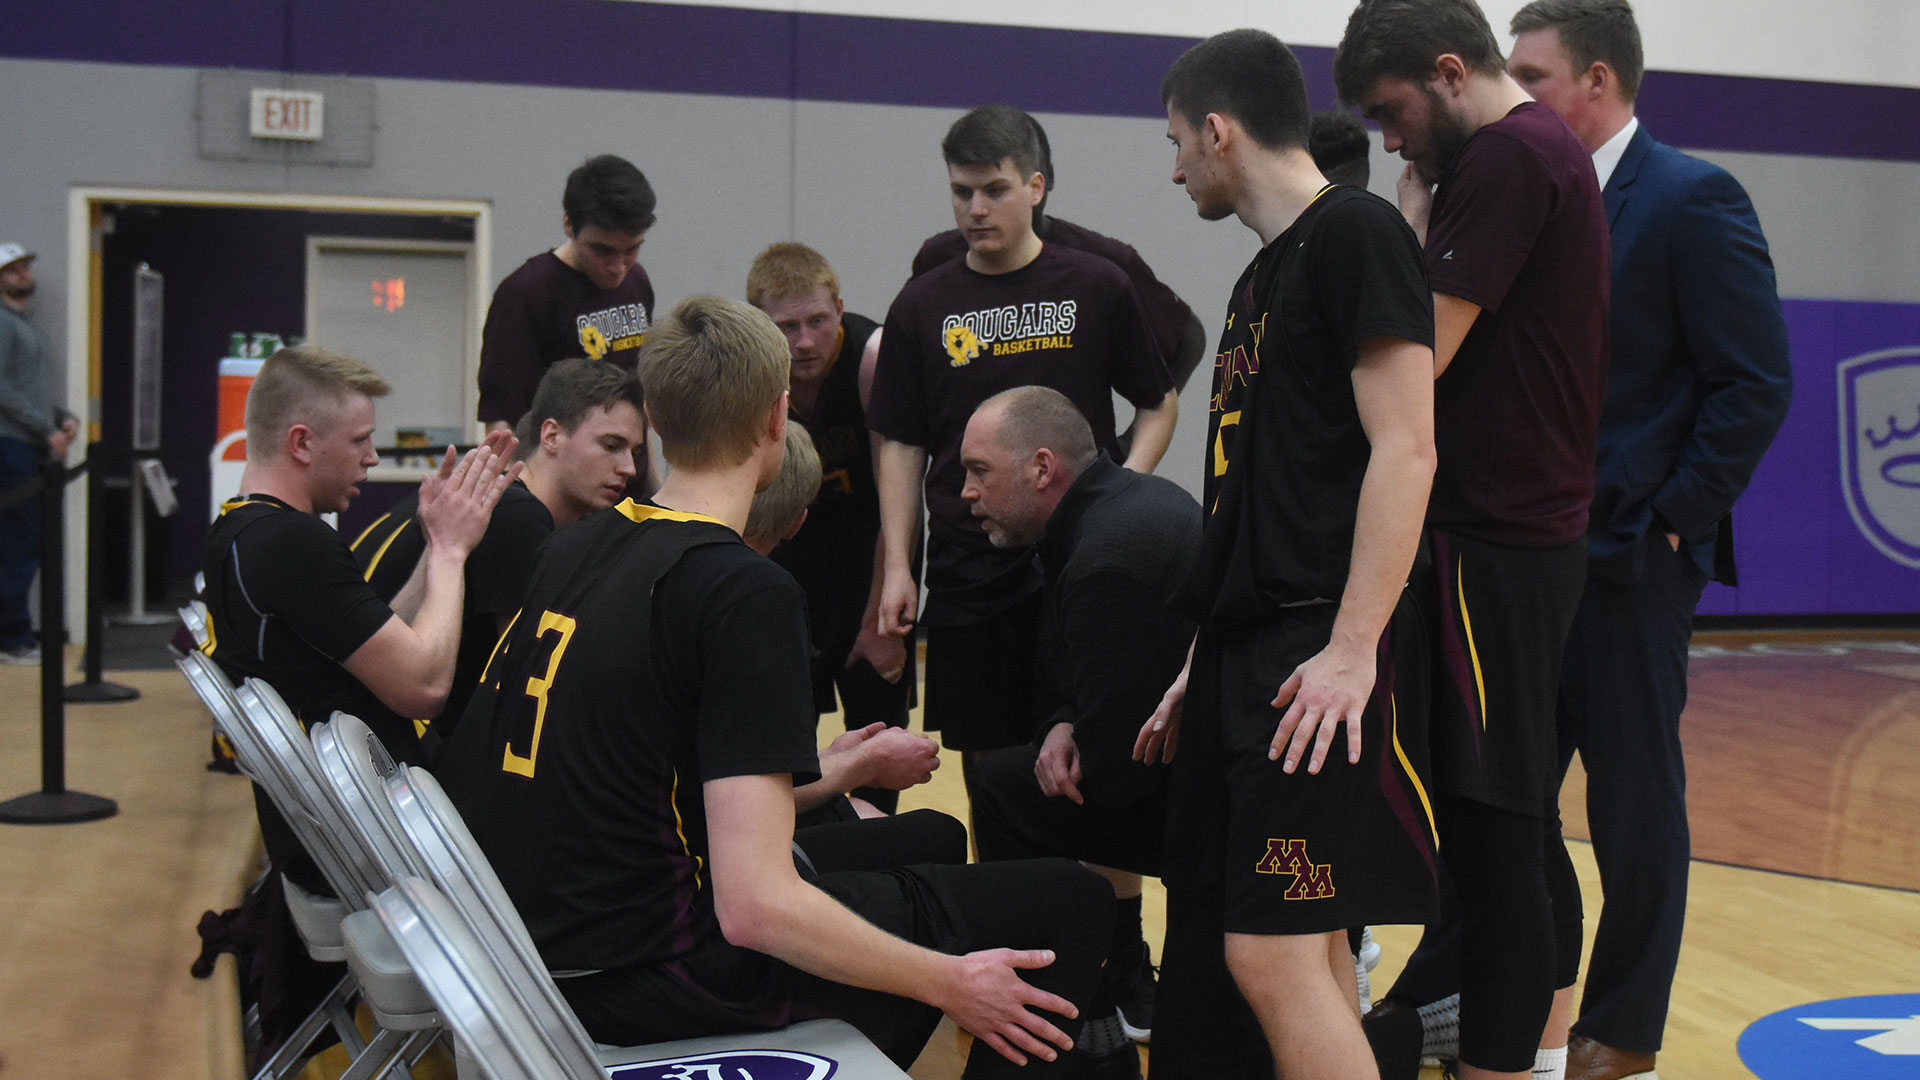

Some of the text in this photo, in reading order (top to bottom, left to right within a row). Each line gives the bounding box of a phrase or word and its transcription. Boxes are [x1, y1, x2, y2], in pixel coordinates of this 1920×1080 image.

[264, 95, 312, 132] EXIT
[942, 300, 1076, 348] COUGARS
[993, 336, 1074, 356] BASKETBALL
